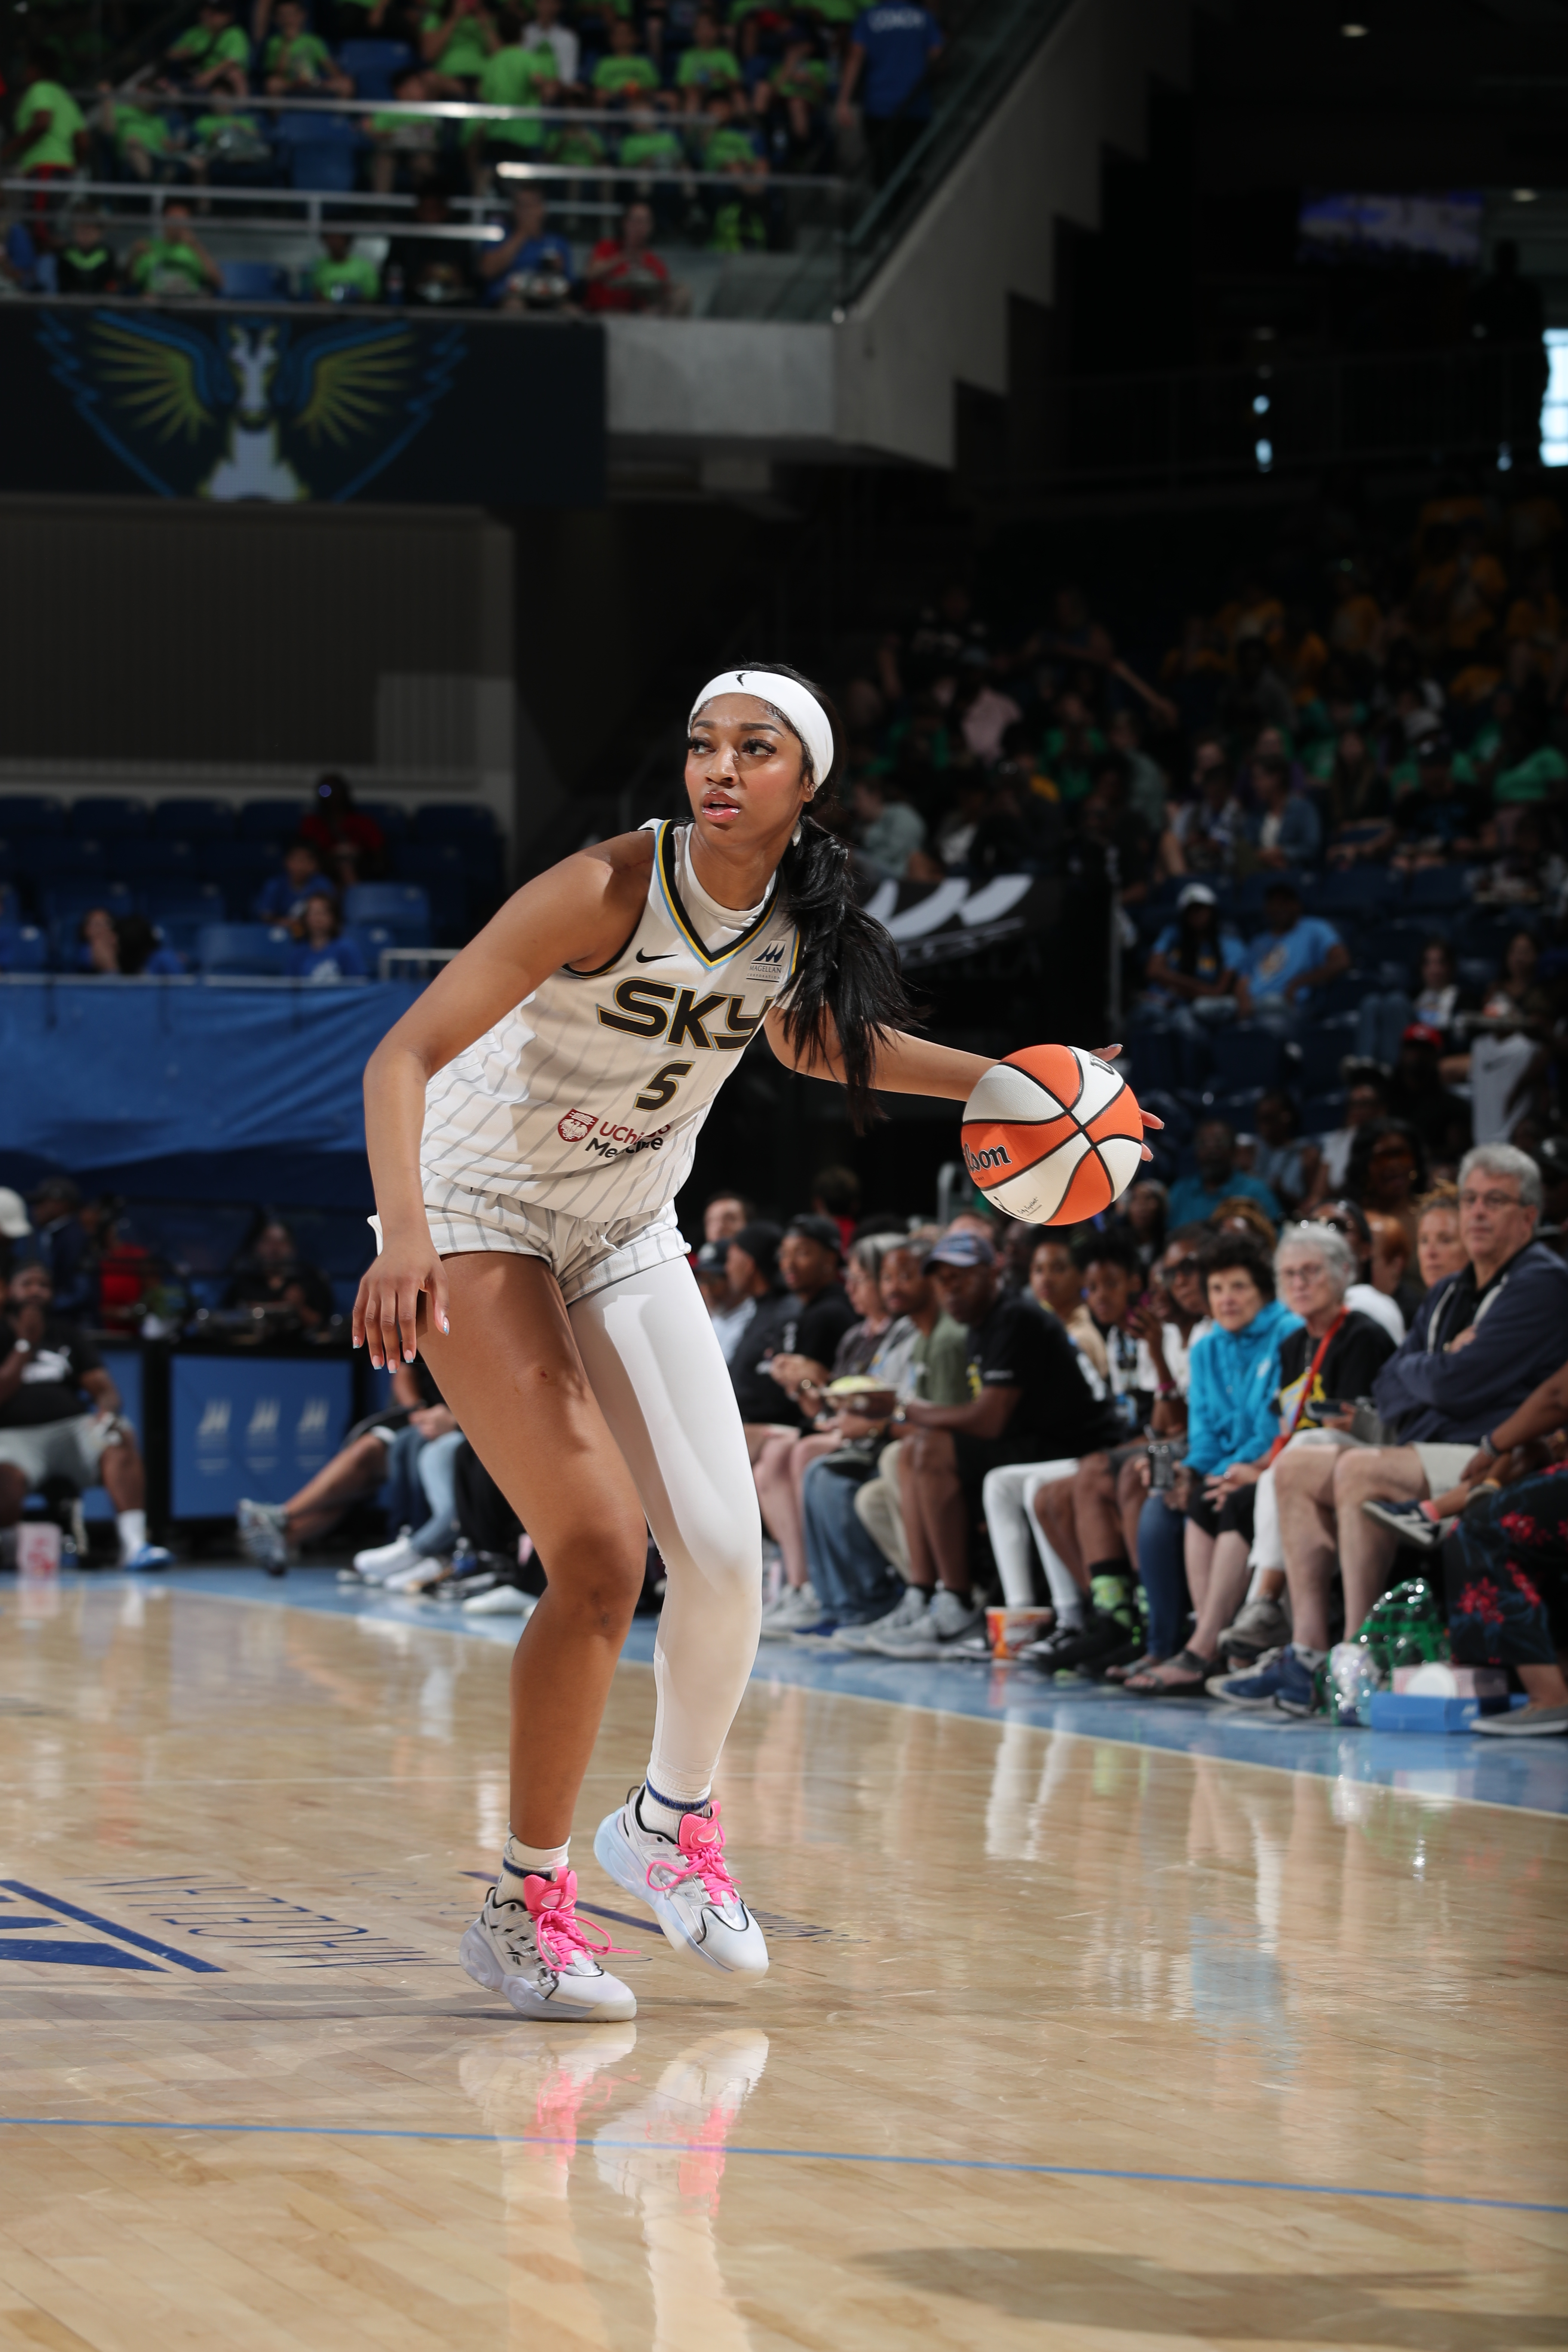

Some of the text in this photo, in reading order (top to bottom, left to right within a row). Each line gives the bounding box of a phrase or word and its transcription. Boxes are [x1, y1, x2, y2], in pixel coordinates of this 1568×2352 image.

[596, 977, 776, 1051] SKY
[633, 1060, 696, 1112] 5
[963, 1142, 1012, 1173] lson
